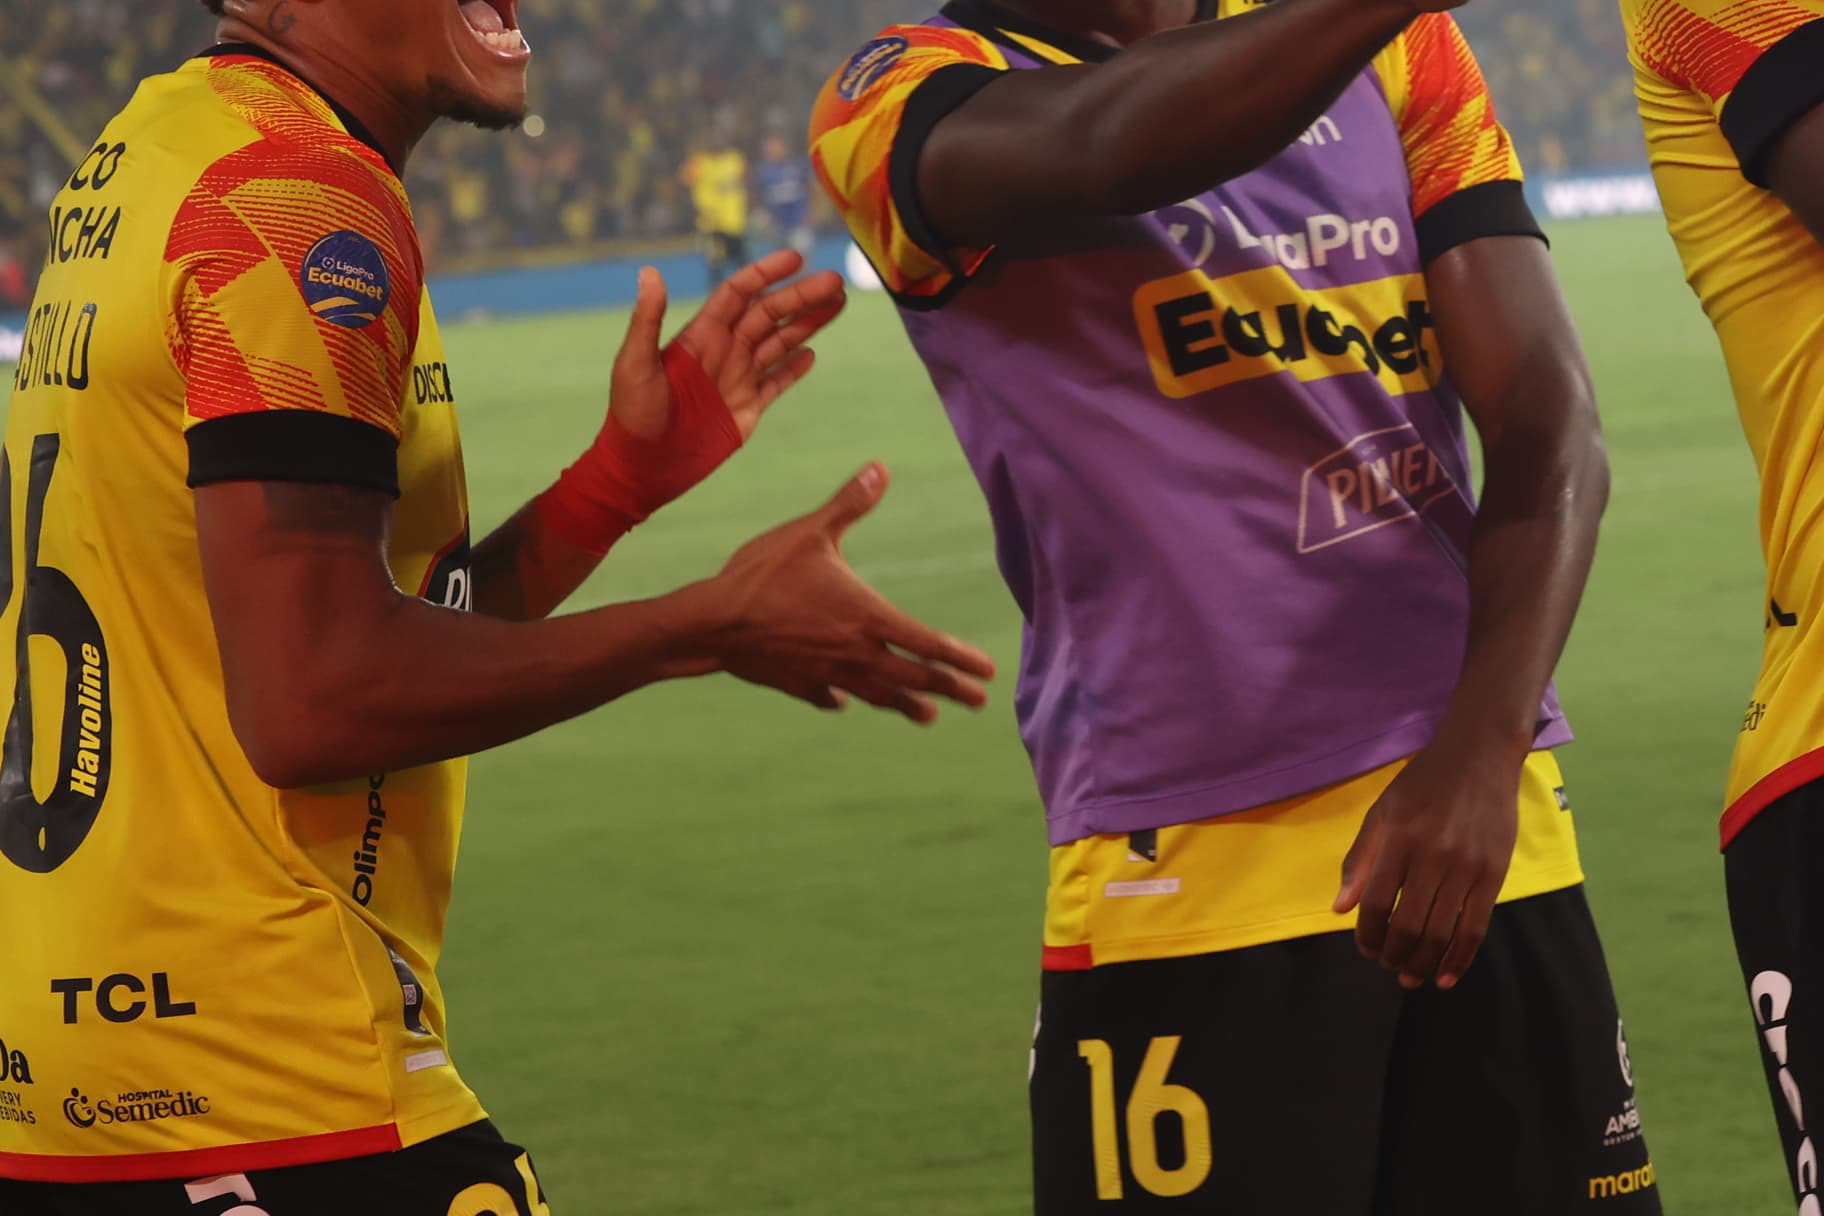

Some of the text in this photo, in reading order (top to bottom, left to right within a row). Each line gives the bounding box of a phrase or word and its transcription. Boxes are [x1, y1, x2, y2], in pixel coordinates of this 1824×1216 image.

[69, 141, 126, 191] CO
[308, 267, 384, 302] Ecuabet
[336, 260, 375, 281] LigaPro
[13, 299, 97, 391] STILLO
[70, 641, 101, 799] Havoline
[50, 971, 197, 1025] TCL
[0, 1105, 37, 1125] EBIDAS
[97, 1090, 211, 1125] Semedic
[118, 1089, 173, 1103] HOSPITAL
[1077, 1034, 1213, 1201] 16
